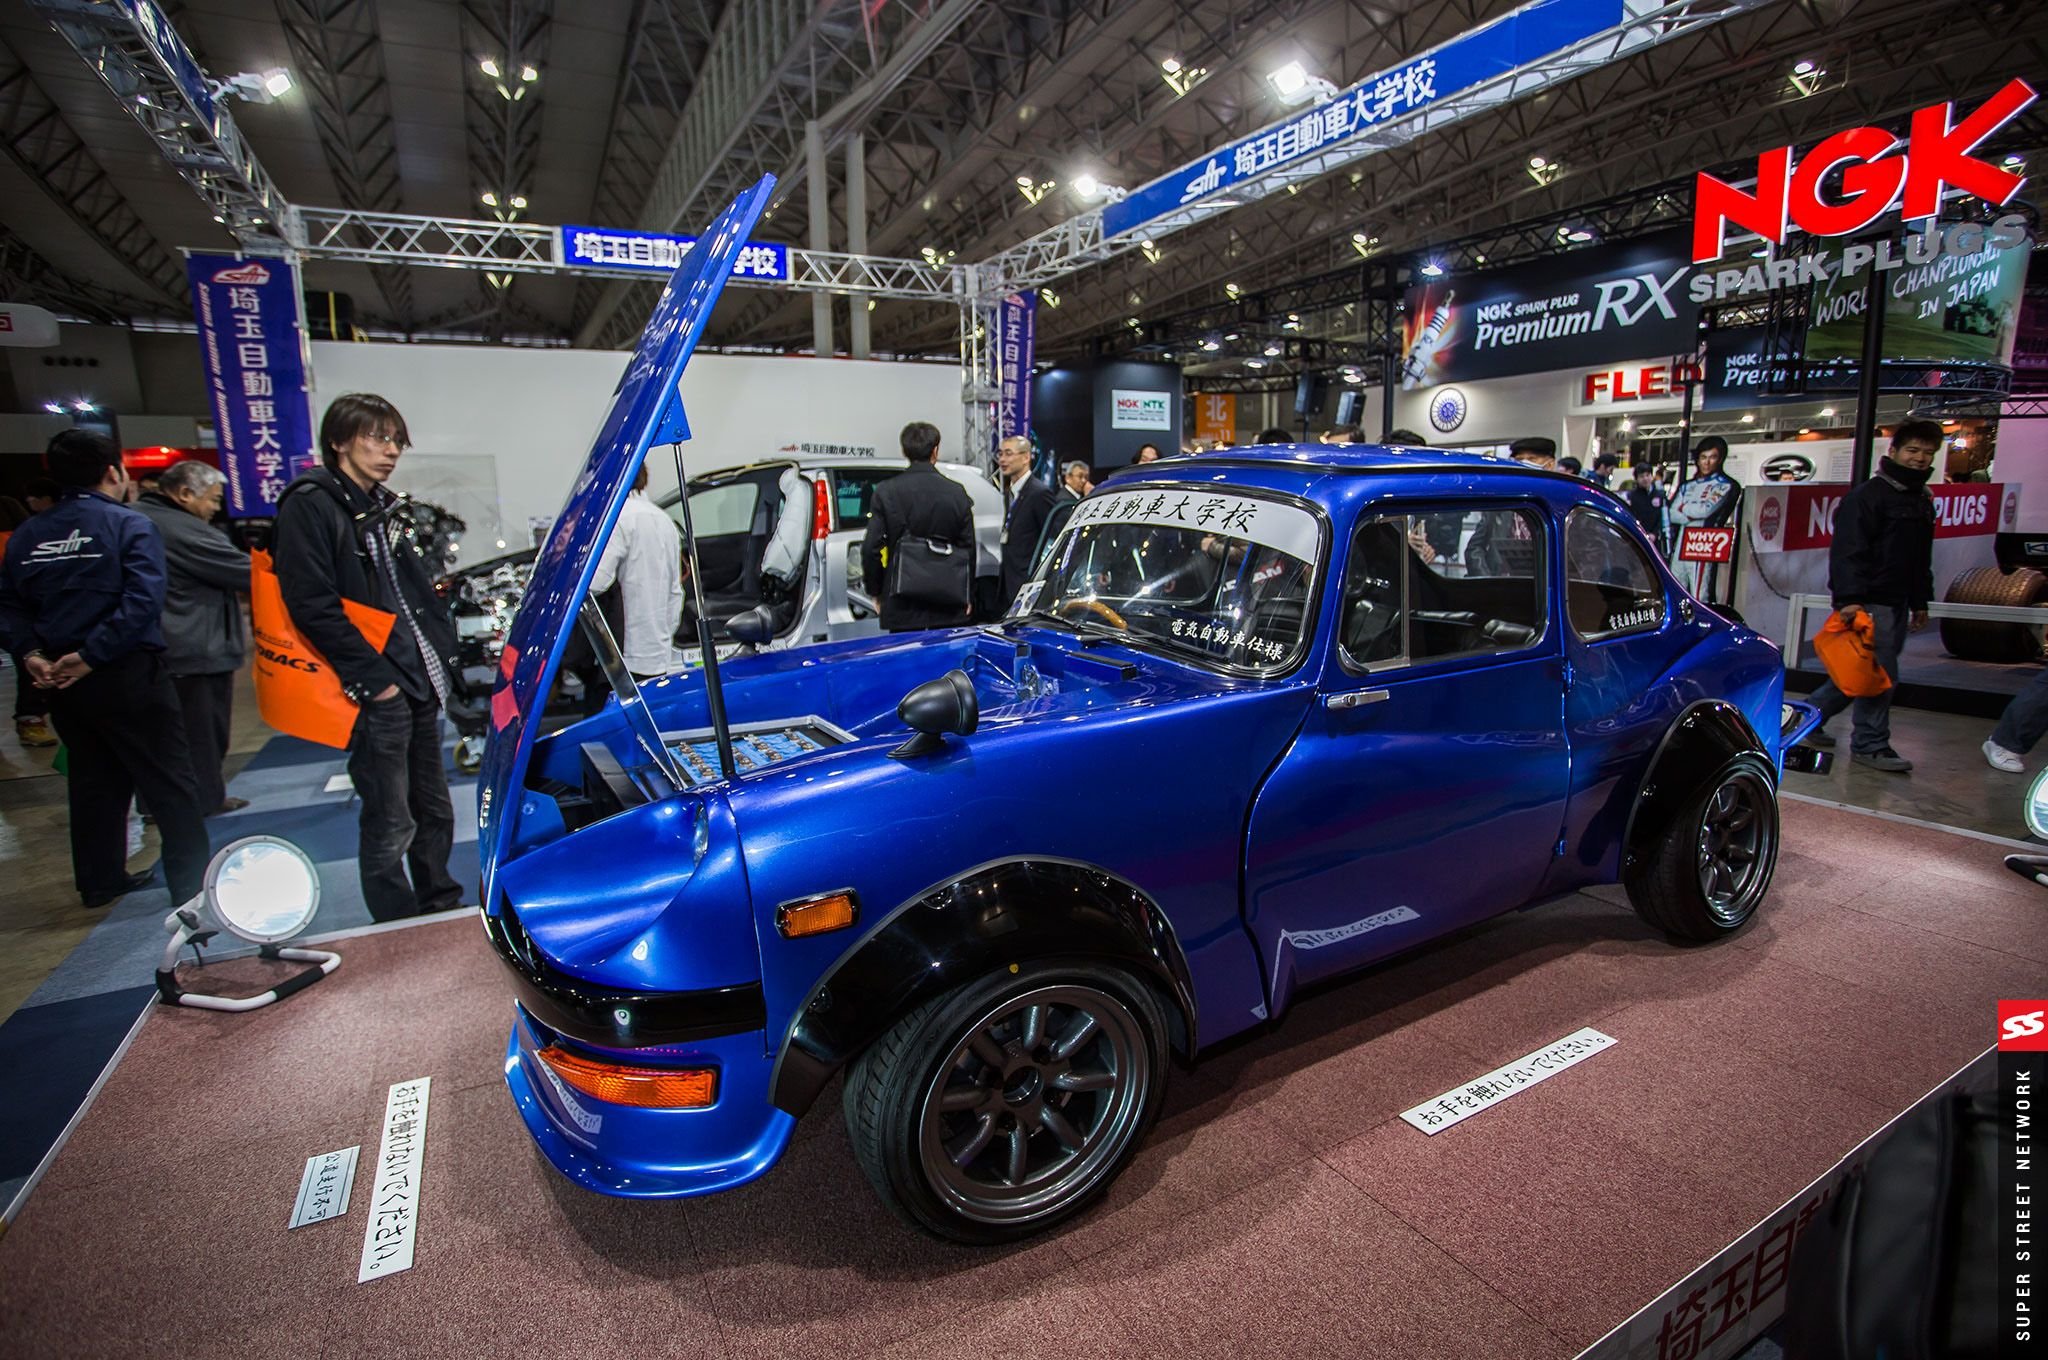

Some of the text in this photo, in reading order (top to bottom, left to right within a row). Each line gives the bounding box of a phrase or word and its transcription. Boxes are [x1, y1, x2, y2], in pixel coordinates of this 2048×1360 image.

[1234, 59, 1437, 177] 埼玉自動車大学校
[1692, 76, 2039, 264] NGK
[574, 232, 778, 276] 埼玉自動学校
[1689, 214, 2029, 304] SPARK PLUGS
[1474, 266, 1690, 350] Premium RX
[1476, 293, 1580, 324] NGK SPARK PLUG
[1815, 286, 1869, 327] WORL
[1917, 264, 2002, 320] IN JAPAN
[1725, 352, 1758, 368] NGK
[228, 287, 286, 504] 埼玉自動車大学校
[1206, 395, 1227, 422] 北
[1687, 531, 1715, 541] WHY
[1171, 618, 1283, 661] 電気自動車仕様
[1418, 1036, 1607, 1126] お手を触れないでください。
